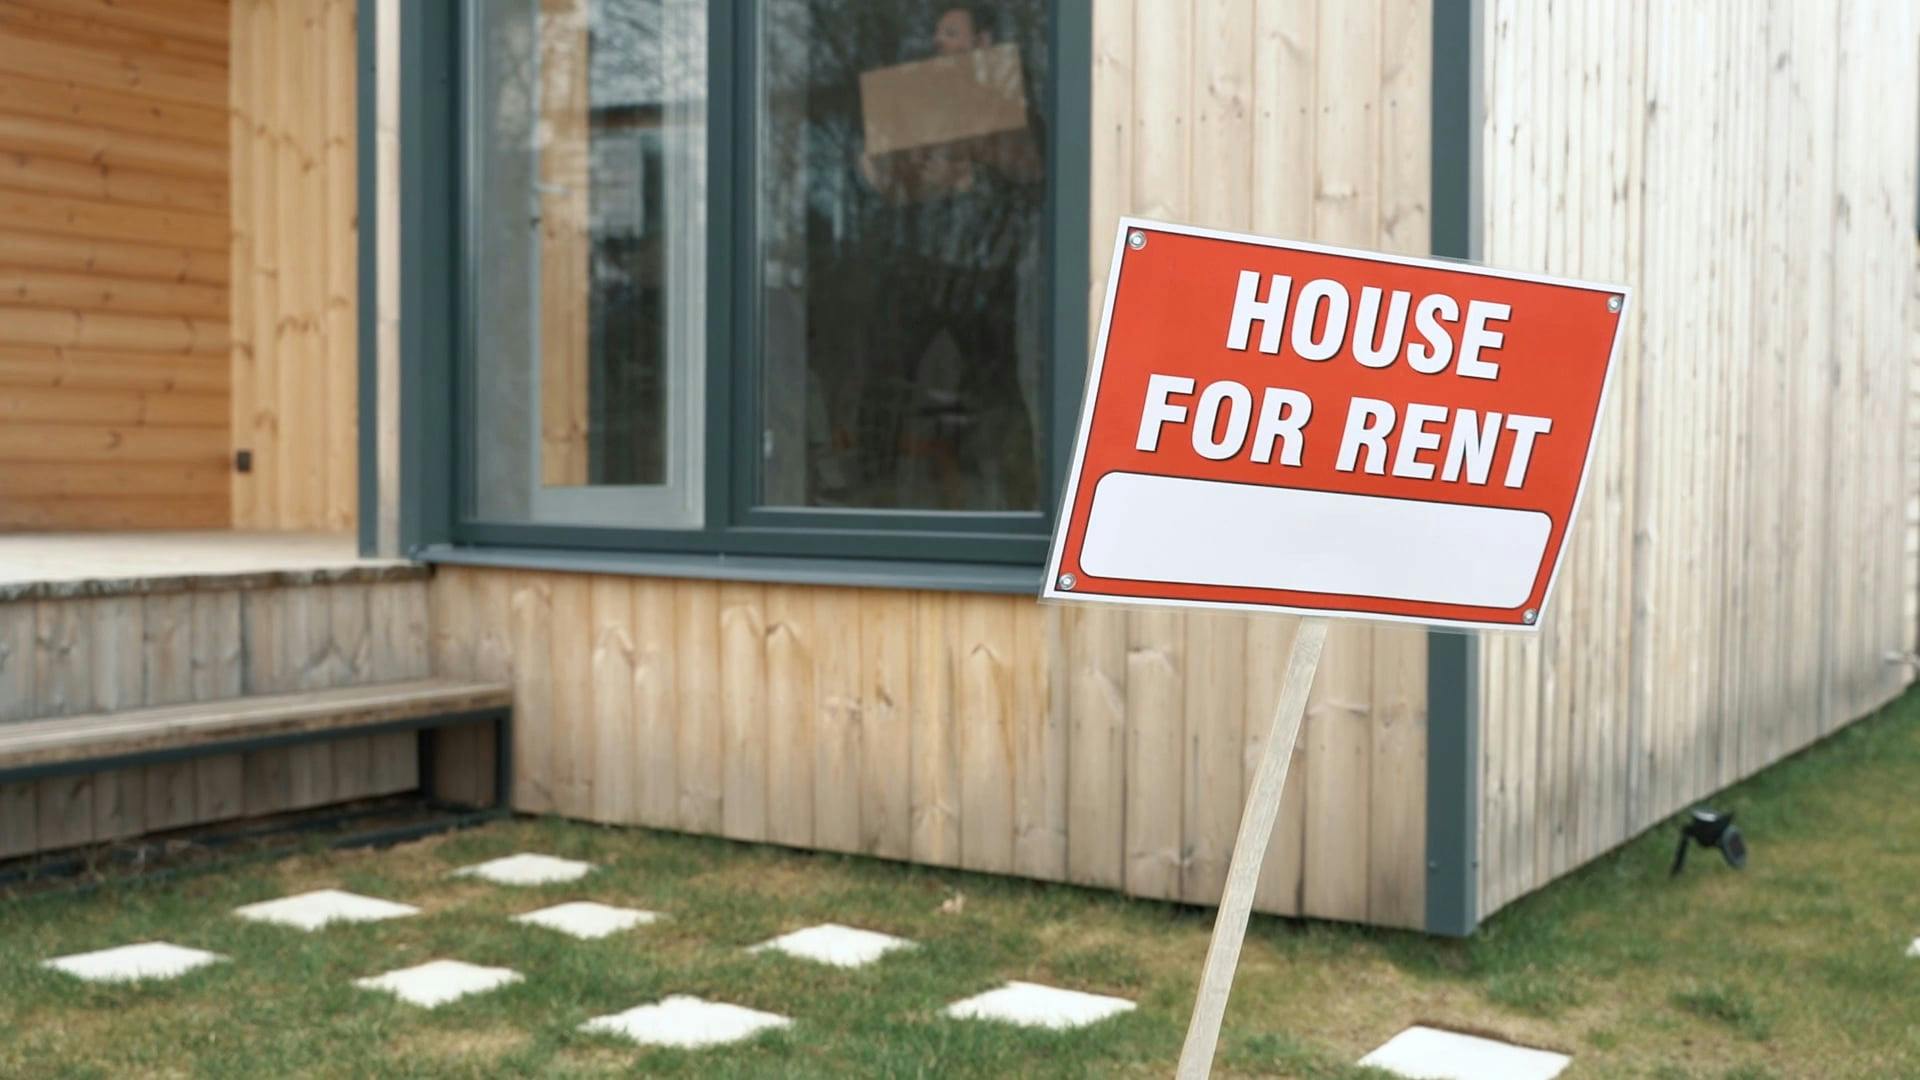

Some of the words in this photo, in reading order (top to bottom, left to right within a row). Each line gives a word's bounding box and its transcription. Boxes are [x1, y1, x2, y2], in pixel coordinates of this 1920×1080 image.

[1226, 270, 1511, 380] HOUSE
[1135, 373, 1312, 466] FOR
[1335, 396, 1552, 488] RENT
